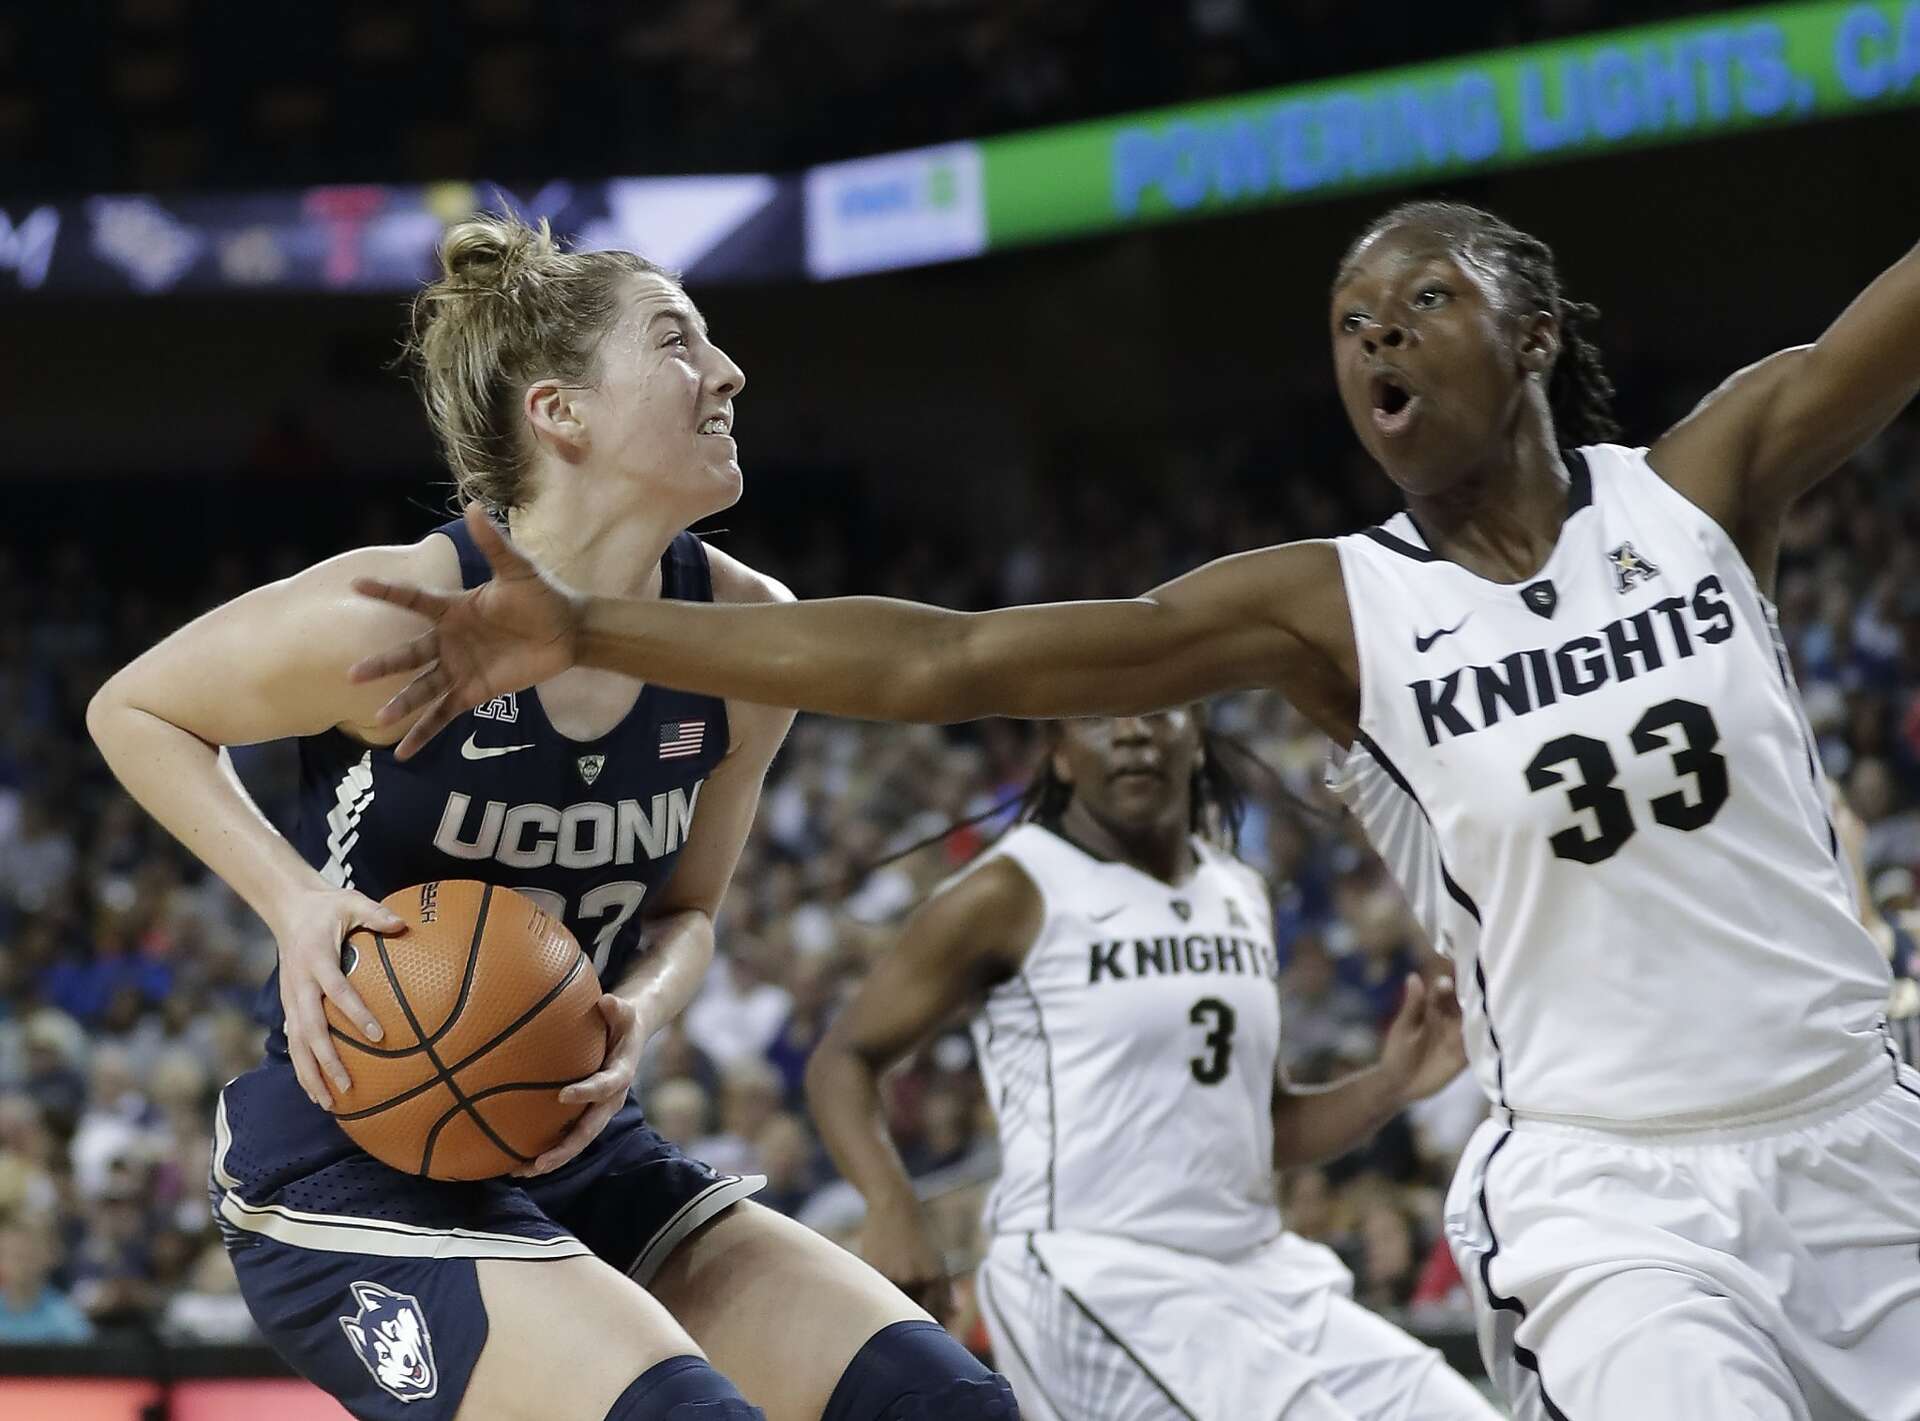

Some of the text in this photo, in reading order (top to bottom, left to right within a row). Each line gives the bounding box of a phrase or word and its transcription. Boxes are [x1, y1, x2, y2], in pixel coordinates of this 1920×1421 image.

[1110, 70, 1501, 216] POWERING
[1406, 574, 1735, 747] KNIGHTS
[433, 778, 705, 869] UCONN
[1523, 698, 1730, 864] 33
[1189, 997, 1235, 1085] 3
